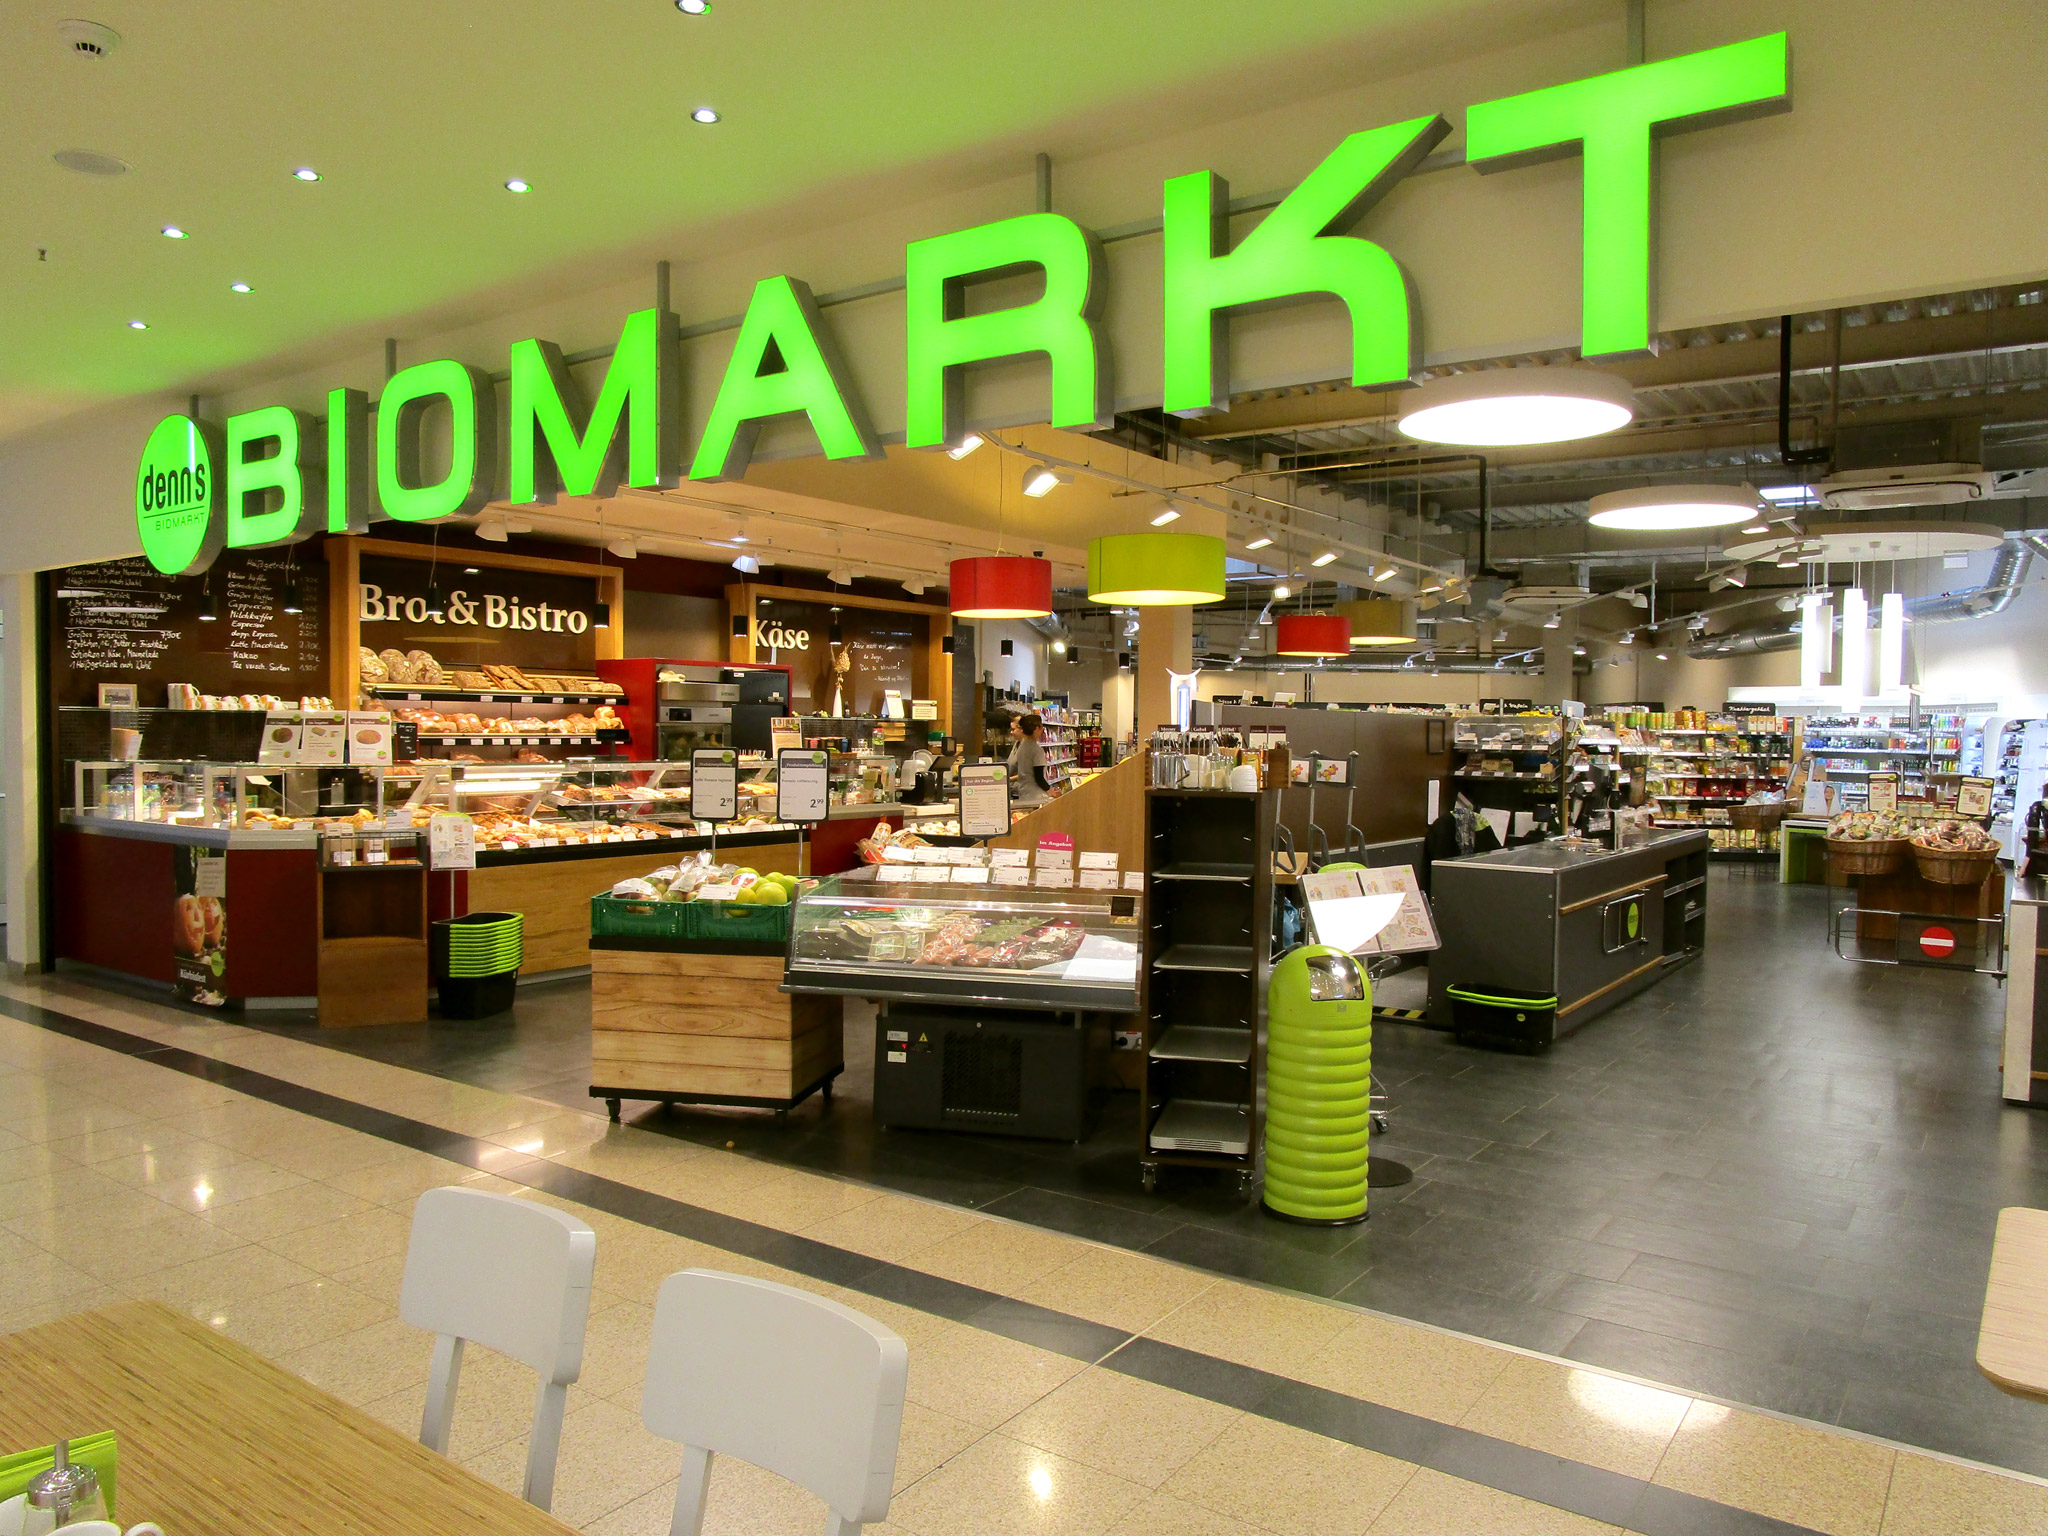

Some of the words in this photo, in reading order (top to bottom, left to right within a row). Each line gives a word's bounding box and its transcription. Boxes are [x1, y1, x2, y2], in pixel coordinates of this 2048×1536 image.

[227, 31, 1788, 548] BIOMARKT
[155, 512, 205, 531] BIOMARKT
[448, 590, 479, 625] &
[483, 594, 588, 634] Bistro
[756, 619, 810, 650] Käse
[233, 650, 259, 660] Kakao
